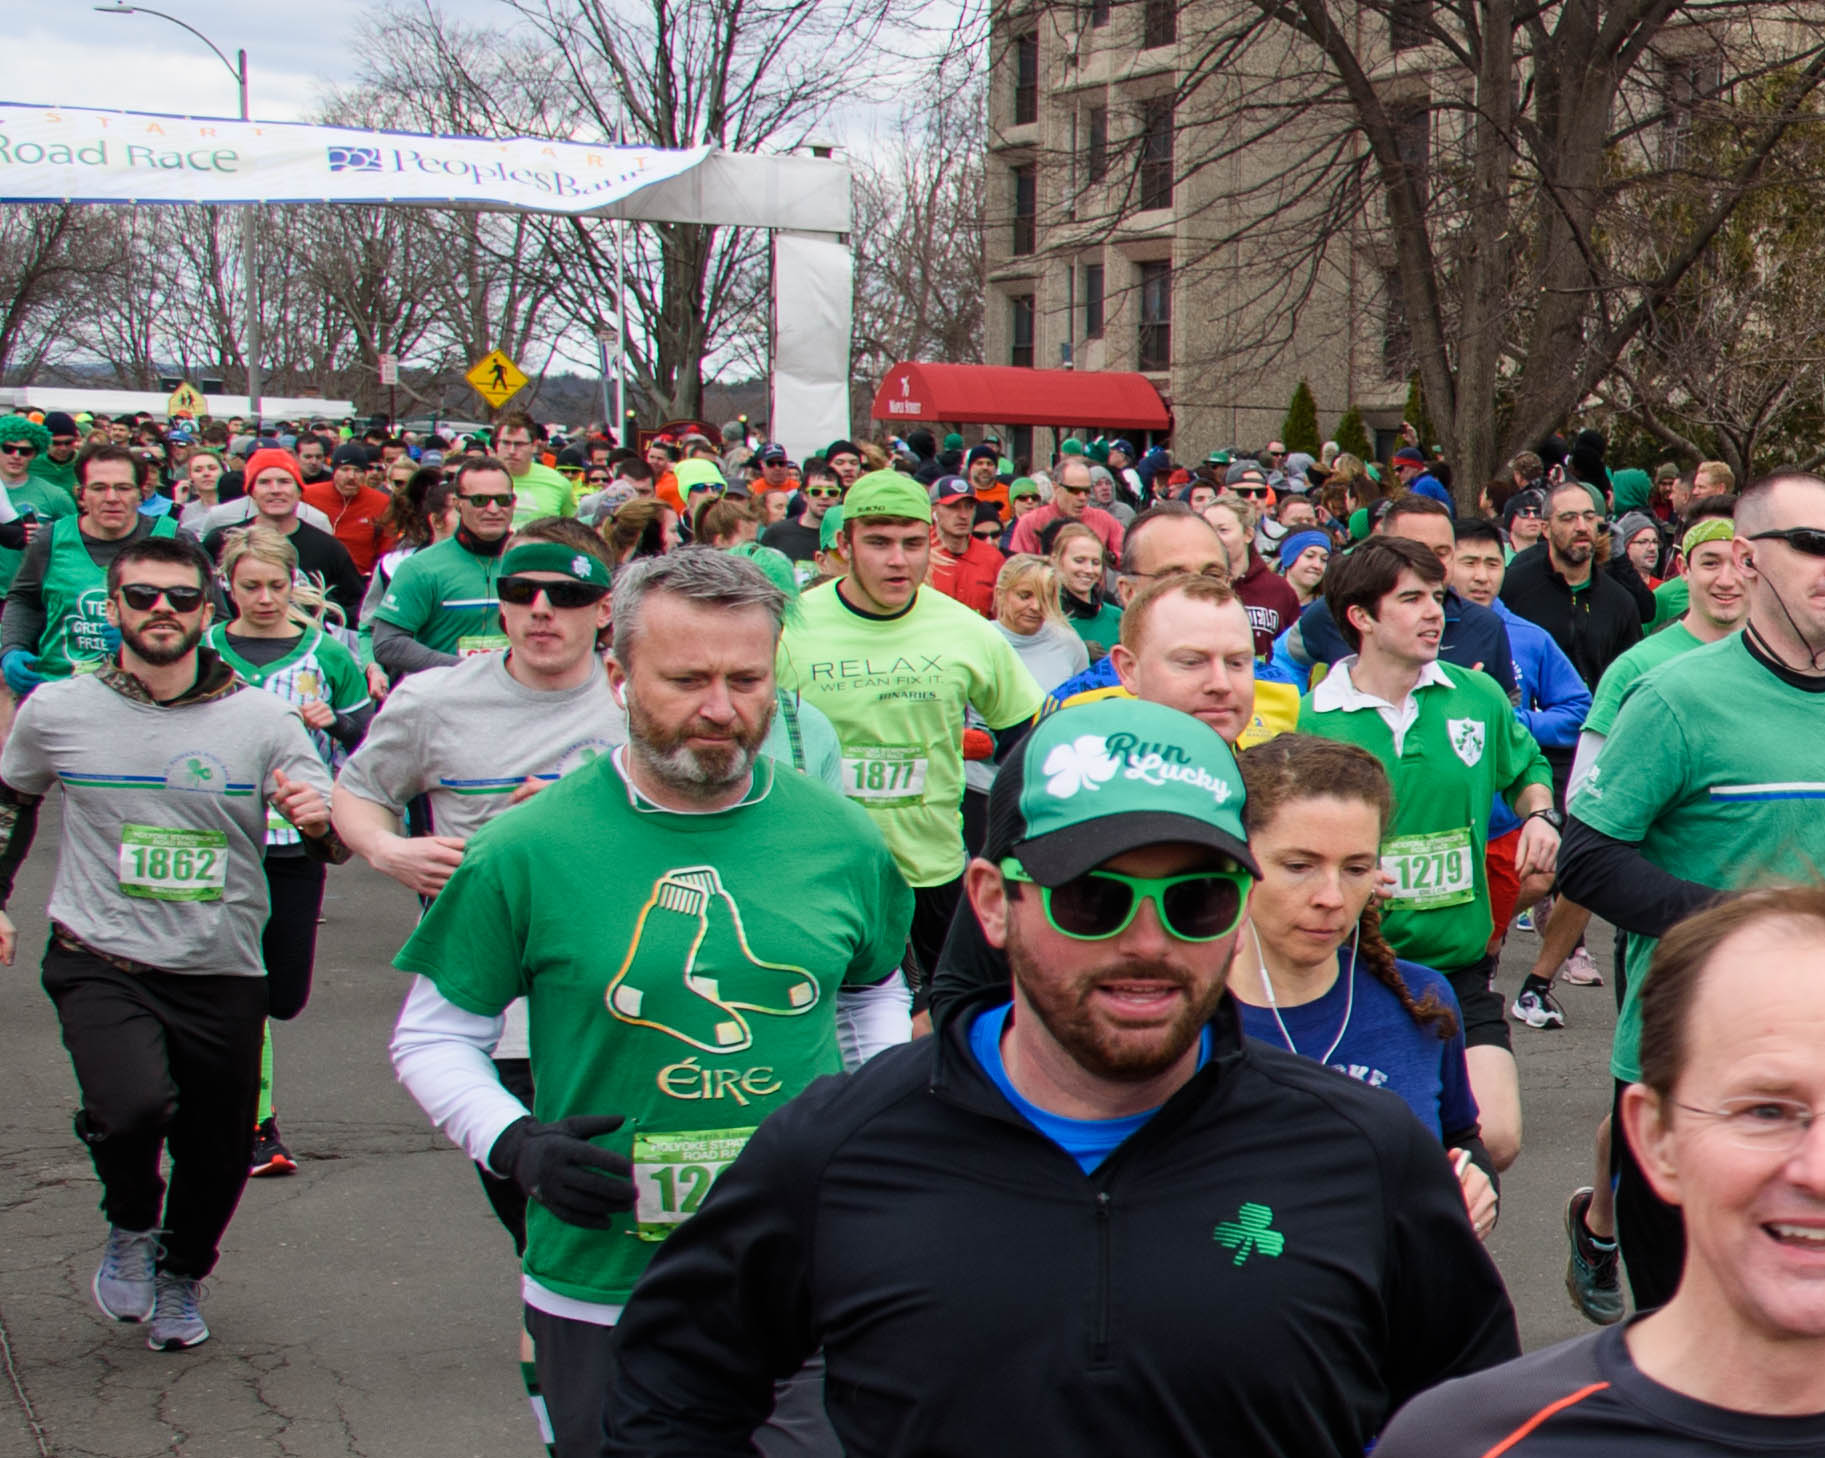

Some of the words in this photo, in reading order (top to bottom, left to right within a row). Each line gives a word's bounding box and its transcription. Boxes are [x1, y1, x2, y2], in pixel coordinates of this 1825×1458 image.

[127, 144, 239, 172] Race
[811, 654, 944, 681] RELAX
[820, 682, 846, 692] WE
[853, 677, 890, 689] CAN
[896, 675, 921, 686] FIX
[1105, 732, 1191, 768] Run
[852, 761, 915, 790] 1877
[1124, 753, 1232, 803] Lucky
[131, 848, 217, 881] 1862
[1395, 850, 1463, 890] 1279
[656, 1056, 783, 1107] ÉIRE
[651, 1165, 734, 1213] 12
